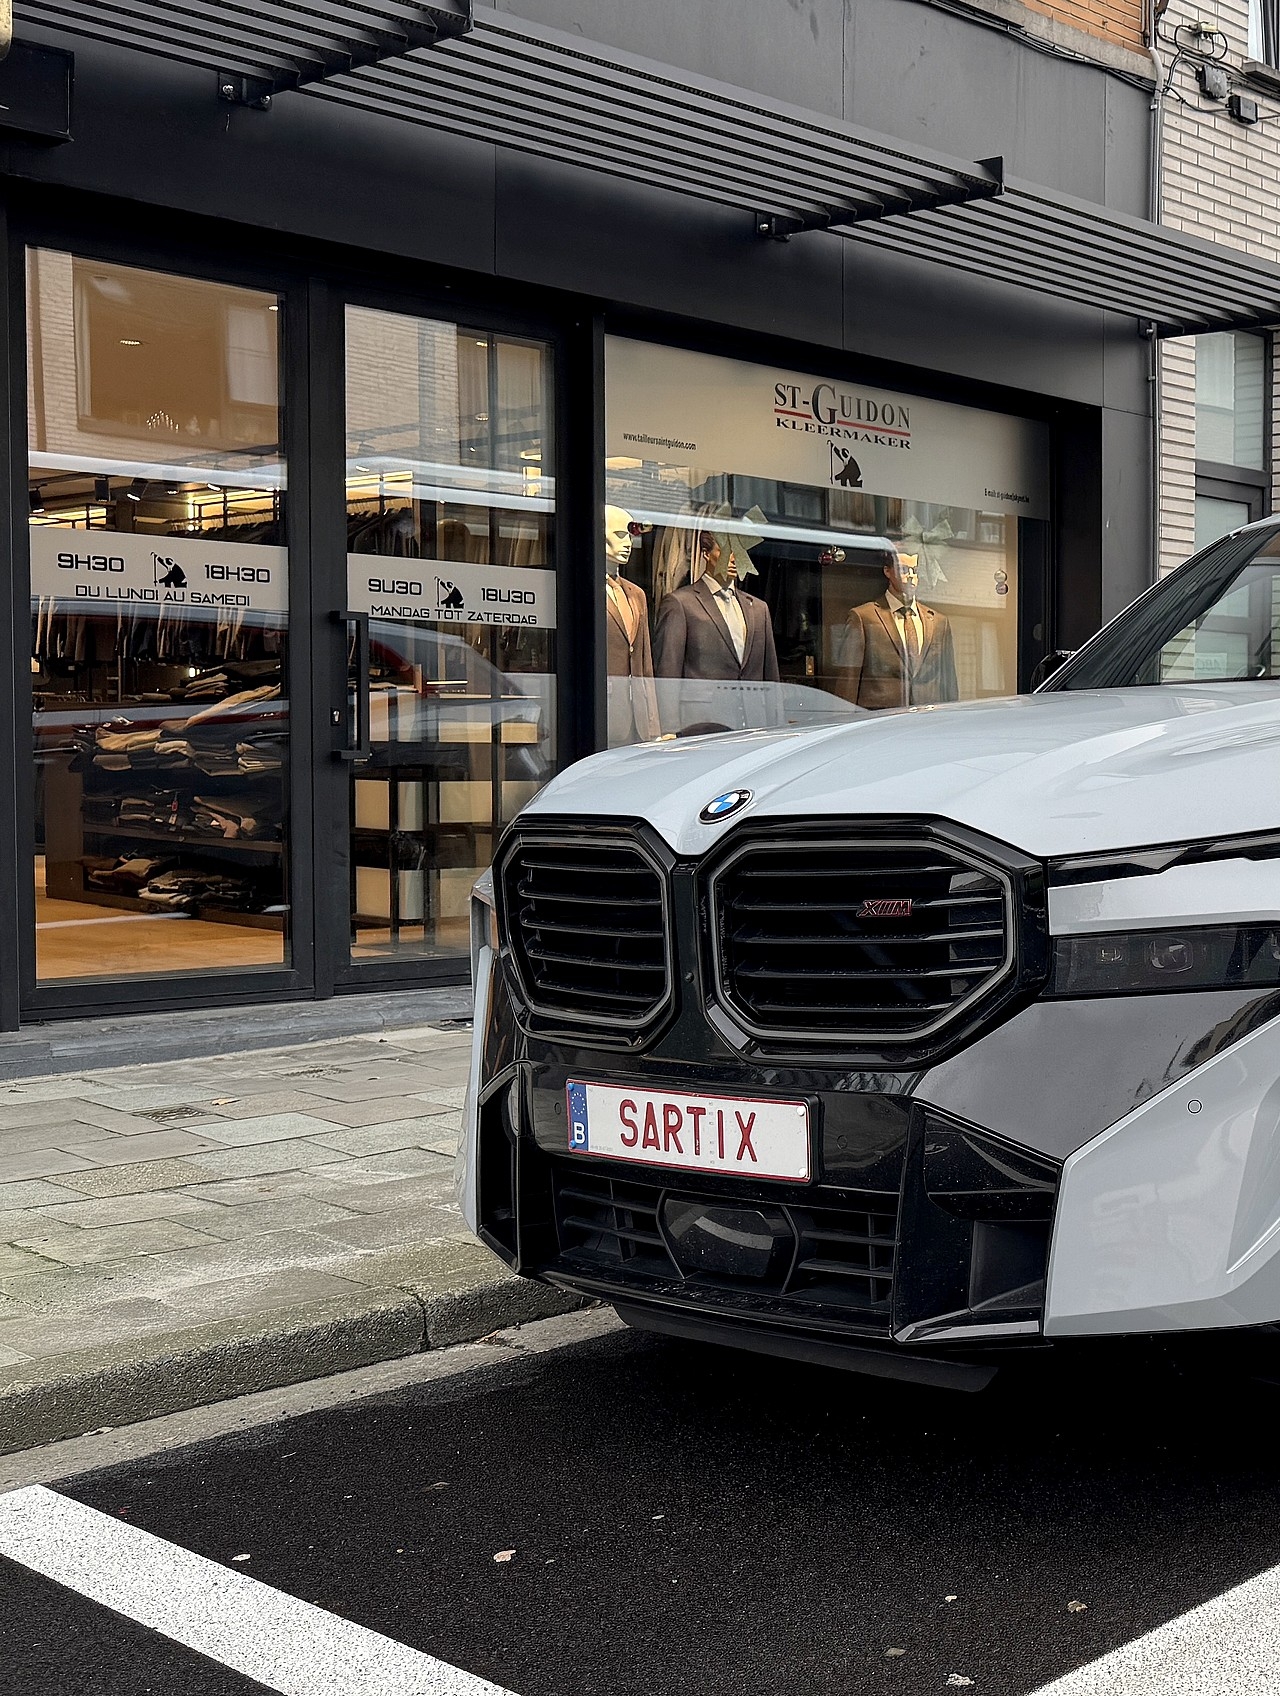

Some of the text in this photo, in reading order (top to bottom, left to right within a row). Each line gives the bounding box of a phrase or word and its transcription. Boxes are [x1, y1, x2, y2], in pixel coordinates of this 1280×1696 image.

[774, 382, 910, 429] ST-GUIDON
[776, 417, 911, 450] KLEERMAKER
[57, 552, 271, 584] 9H30 18H30
[75, 584, 250, 607] DU LUNDI AU SAMEDI
[368, 578, 536, 605] 9U30 18U30
[371, 604, 537, 625] MANDAG TOT ZATERDAG
[573, 1121, 586, 1144] B
[619, 1099, 757, 1163] SARTIX
